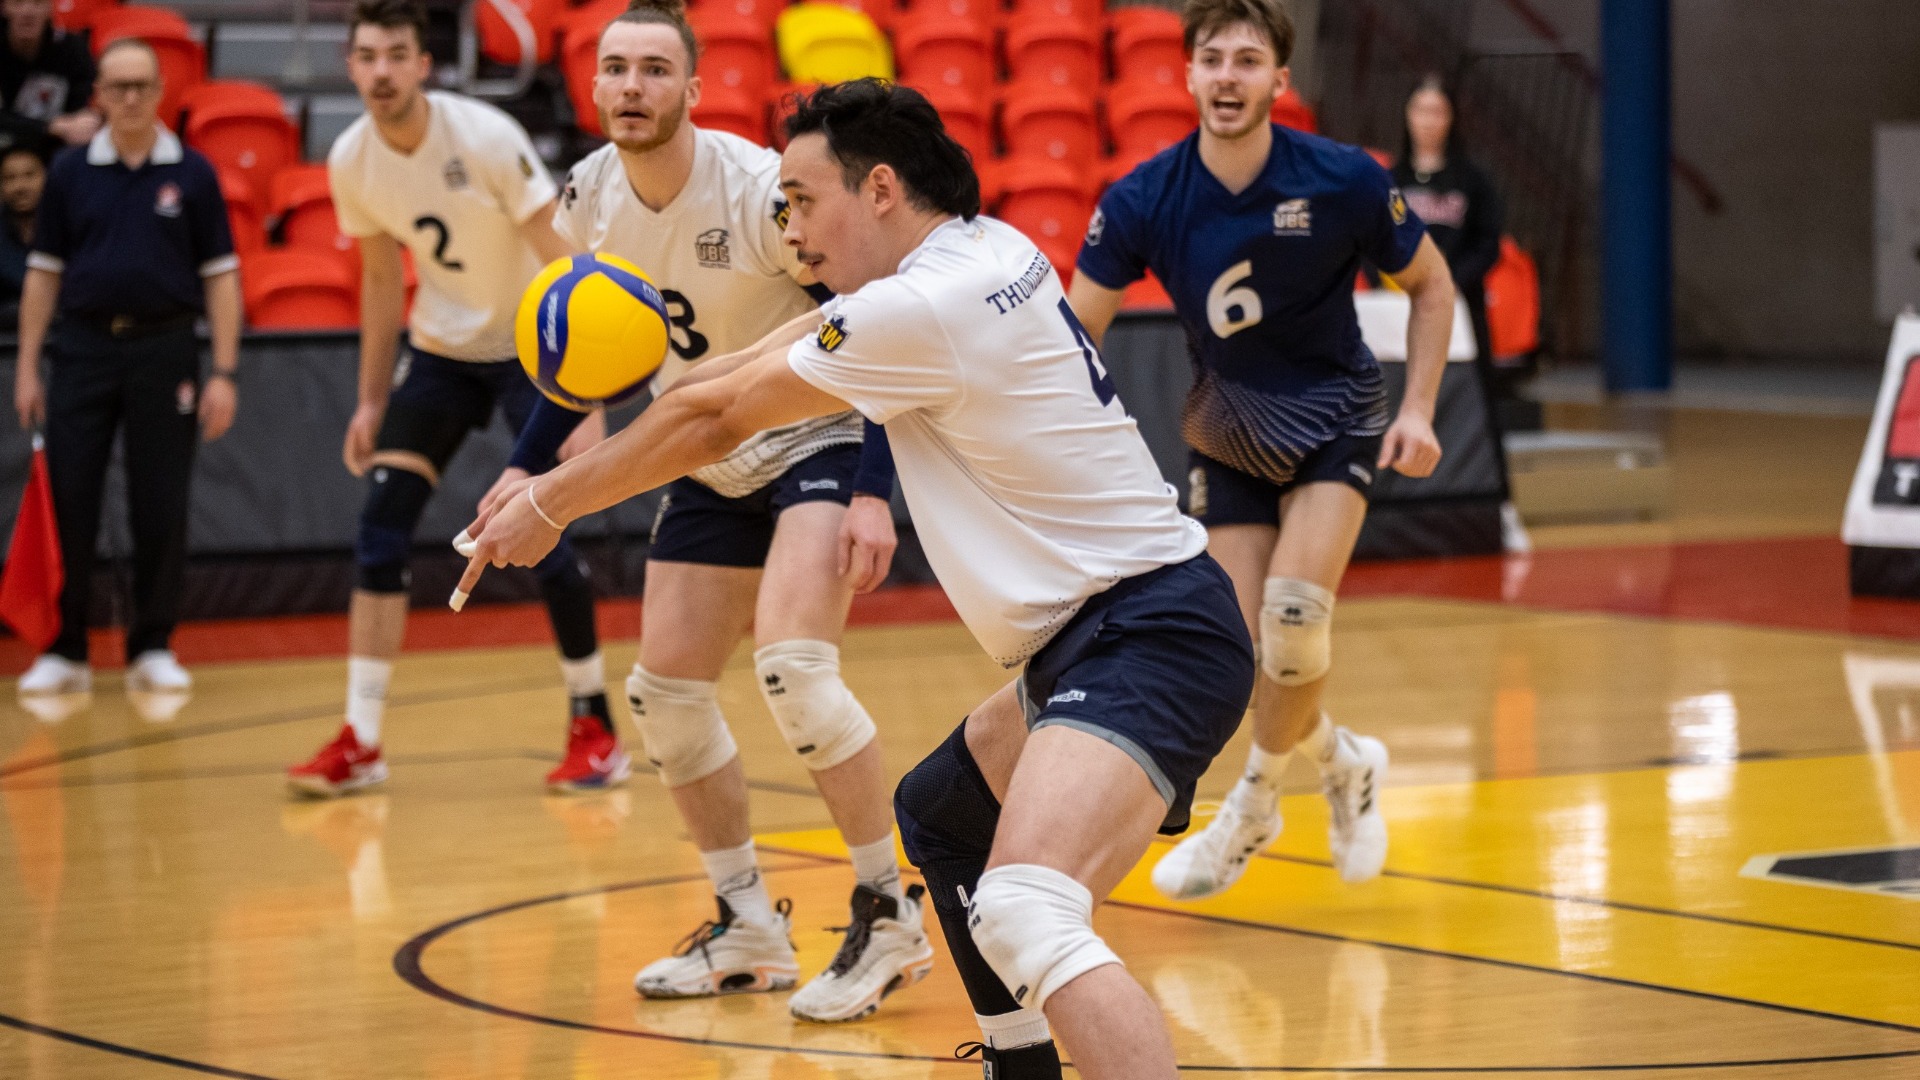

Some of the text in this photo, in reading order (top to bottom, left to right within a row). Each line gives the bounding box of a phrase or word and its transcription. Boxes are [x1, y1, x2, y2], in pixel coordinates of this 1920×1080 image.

[1273, 212, 1312, 228] UBC
[414, 215, 464, 271] 2
[695, 243, 730, 263] UBC
[1206, 259, 1263, 339] 6
